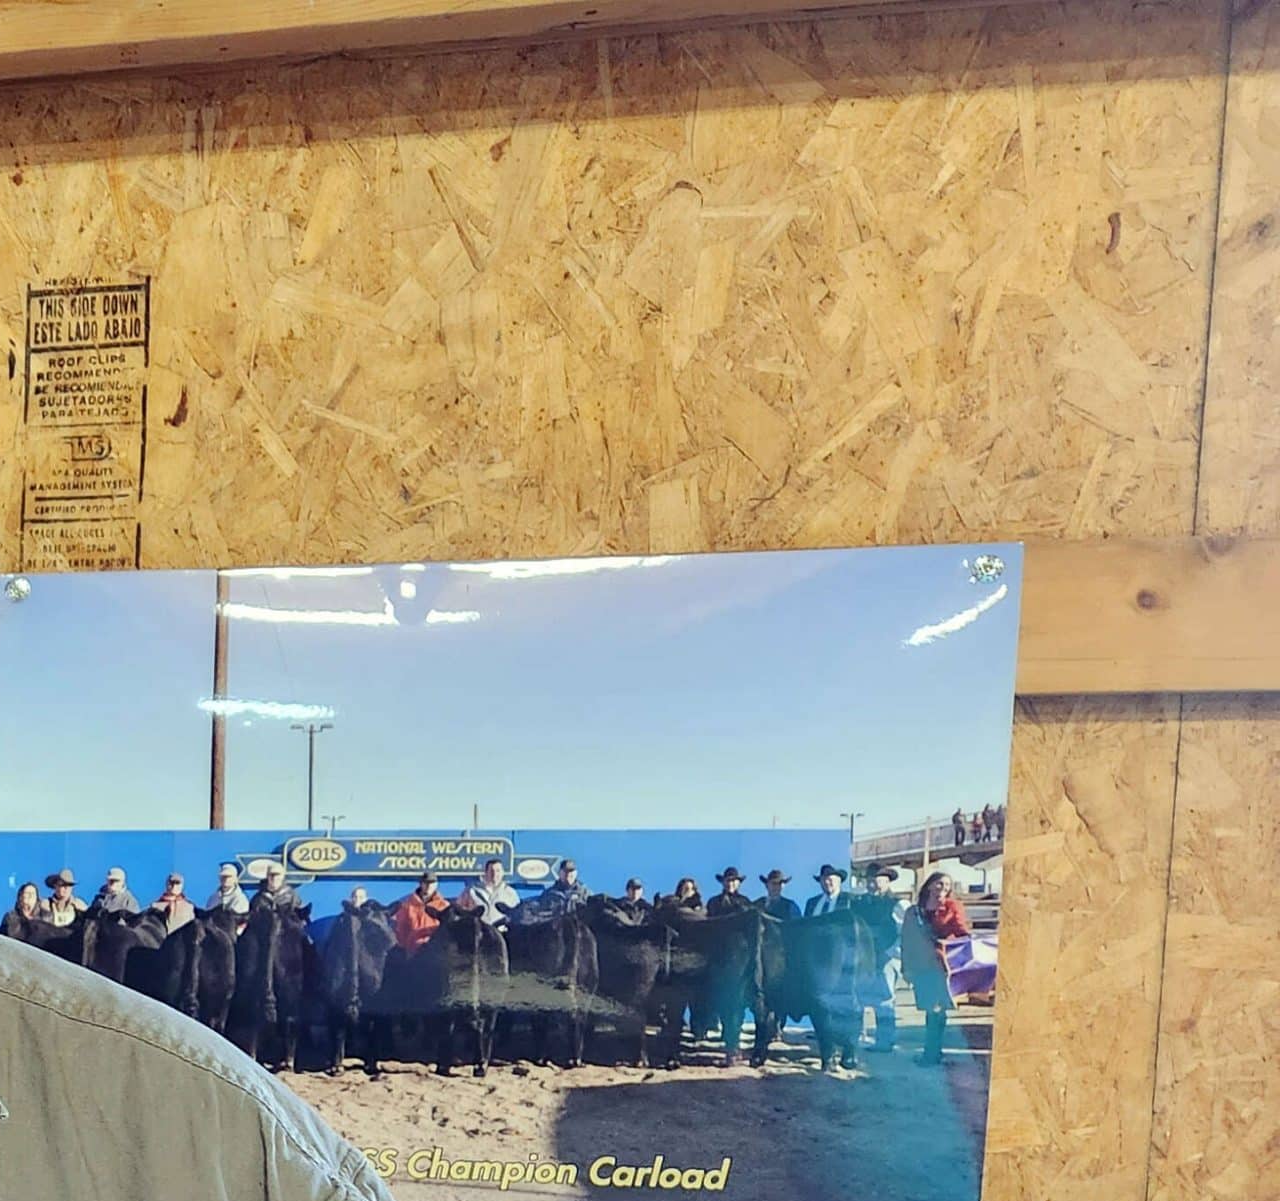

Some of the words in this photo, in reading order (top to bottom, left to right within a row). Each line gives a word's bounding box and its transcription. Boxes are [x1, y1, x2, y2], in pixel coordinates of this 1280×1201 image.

[39, 299, 65, 320] THIS
[70, 296, 97, 317] SIDE
[103, 293, 138, 315] DOWN
[34, 322, 63, 344] ESTE
[68, 321, 98, 342] LADO
[104, 318, 141, 339] ABAJO
[48, 356, 83, 368] ROOF
[89, 354, 126, 365] CLIPS
[37, 367, 135, 382] RECOMMEN
[74, 468, 114, 478] QUALITY
[298, 847, 342, 861] 2015
[355, 841, 426, 854] NATIONAL
[431, 841, 504, 854] WESTERN
[378, 856, 427, 868] STOCK
[428, 856, 477, 869] SHOW
[407, 1146, 579, 1190] Champion
[589, 1154, 731, 1191] Carload
